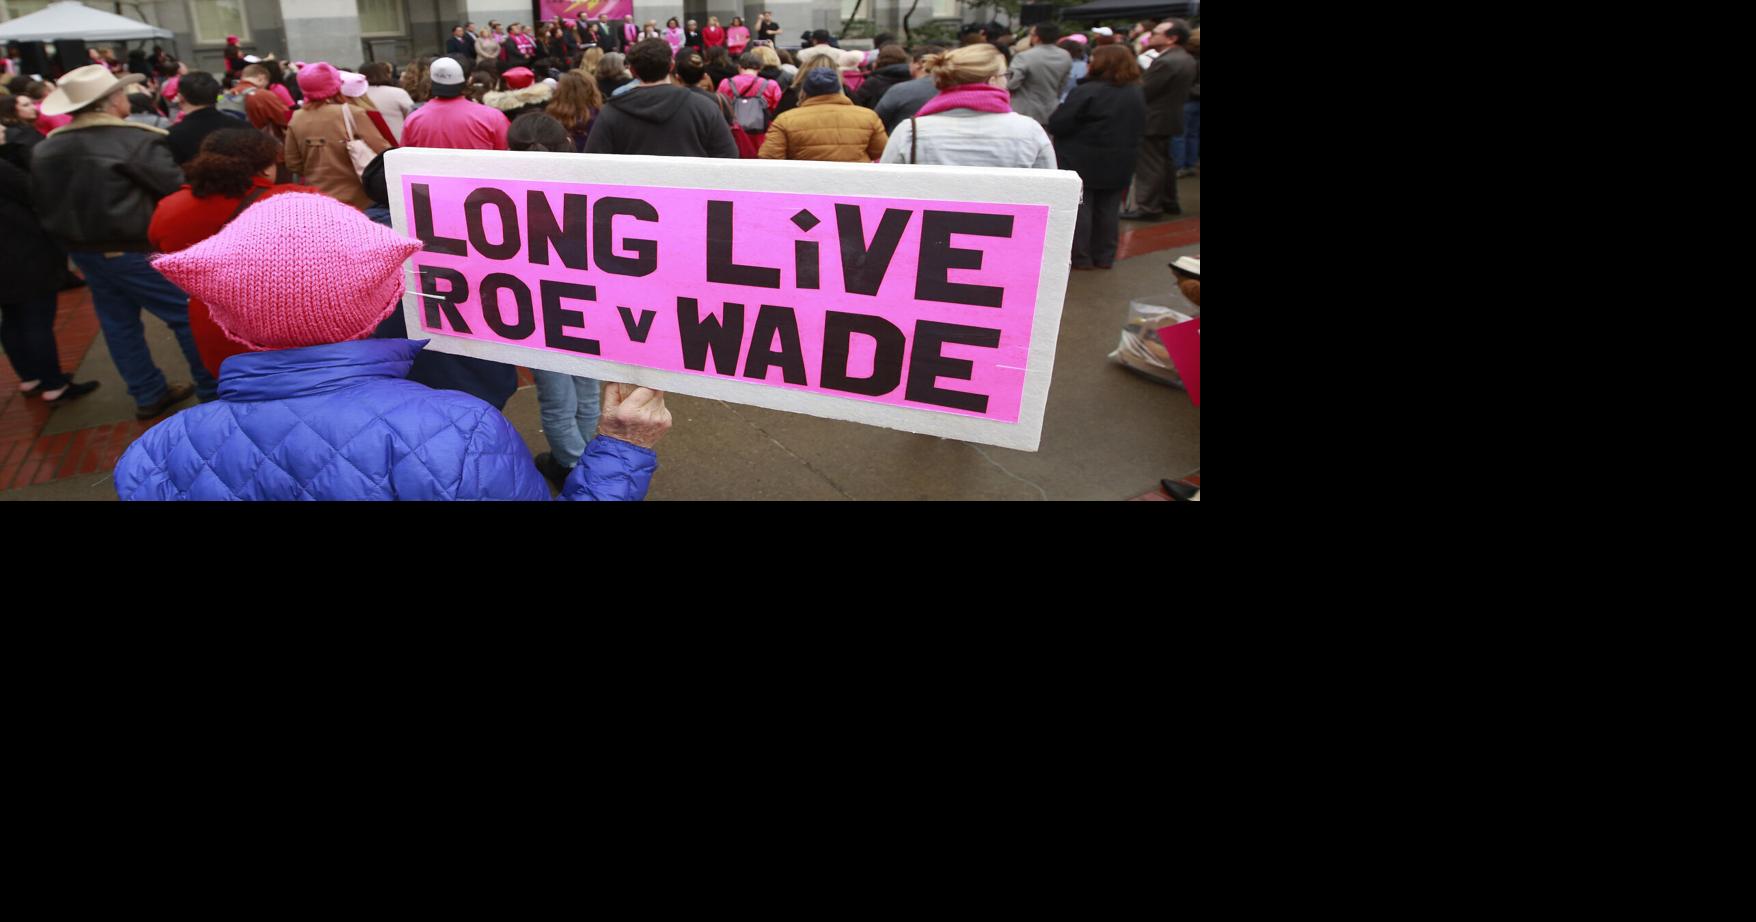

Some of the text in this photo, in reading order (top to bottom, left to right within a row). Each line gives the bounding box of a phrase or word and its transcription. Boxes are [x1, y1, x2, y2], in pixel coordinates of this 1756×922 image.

[411, 183, 659, 278] LONG
[420, 264, 600, 356] ROE
[677, 296, 1001, 414] WADE
